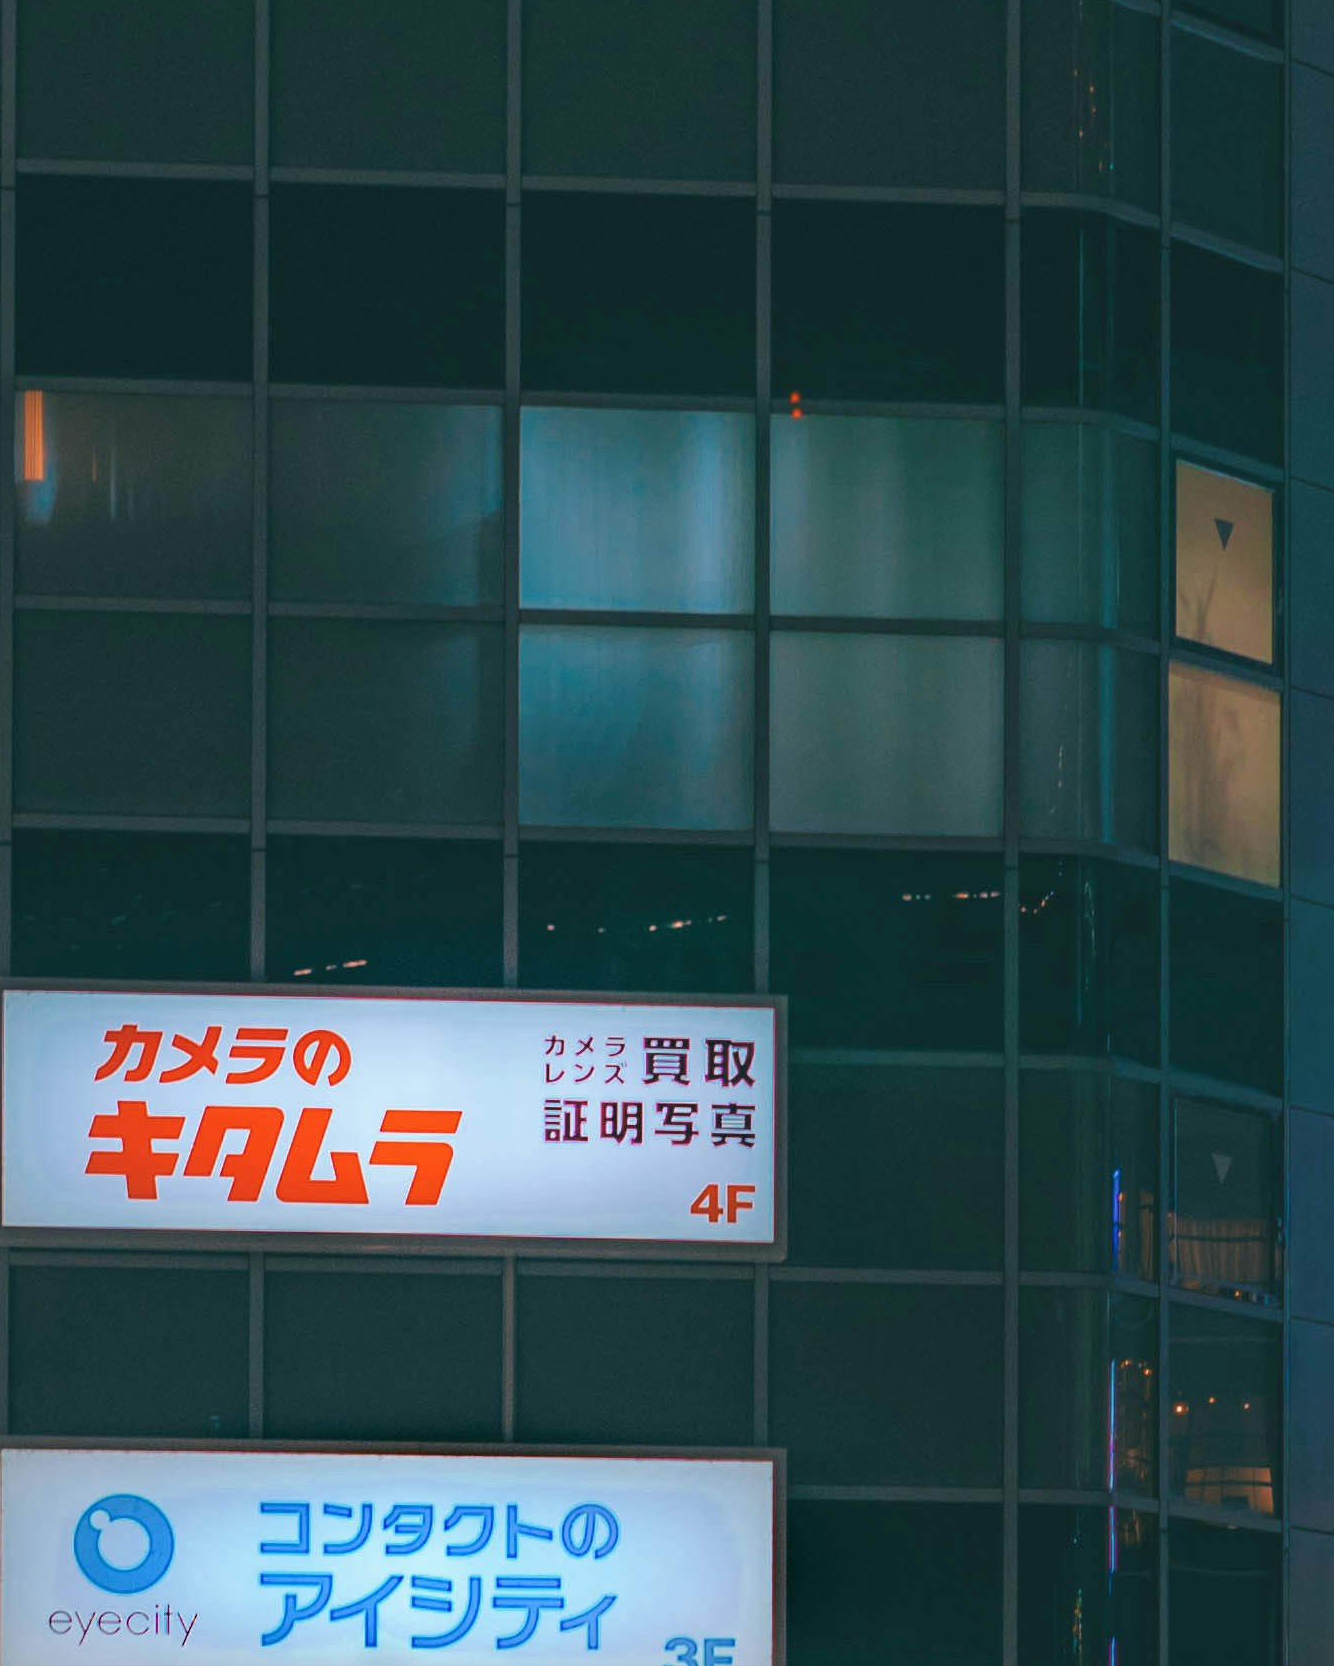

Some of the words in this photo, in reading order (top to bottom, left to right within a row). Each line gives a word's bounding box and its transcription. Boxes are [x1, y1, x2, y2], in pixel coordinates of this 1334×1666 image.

[94, 1023, 352, 1087] カメラの
[543, 1035, 627, 1059] カメラ
[643, 1036, 757, 1088] 買取
[543, 1062, 627, 1086] レンズ
[543, 1099, 757, 1149] 証明写真
[83, 1099, 464, 1206] キタムラ
[690, 1184, 756, 1224] 4F
[258, 1500, 621, 1561] コンタクトの
[48, 1603, 199, 1646] eyecity
[258, 1572, 618, 1651] アイシティ
